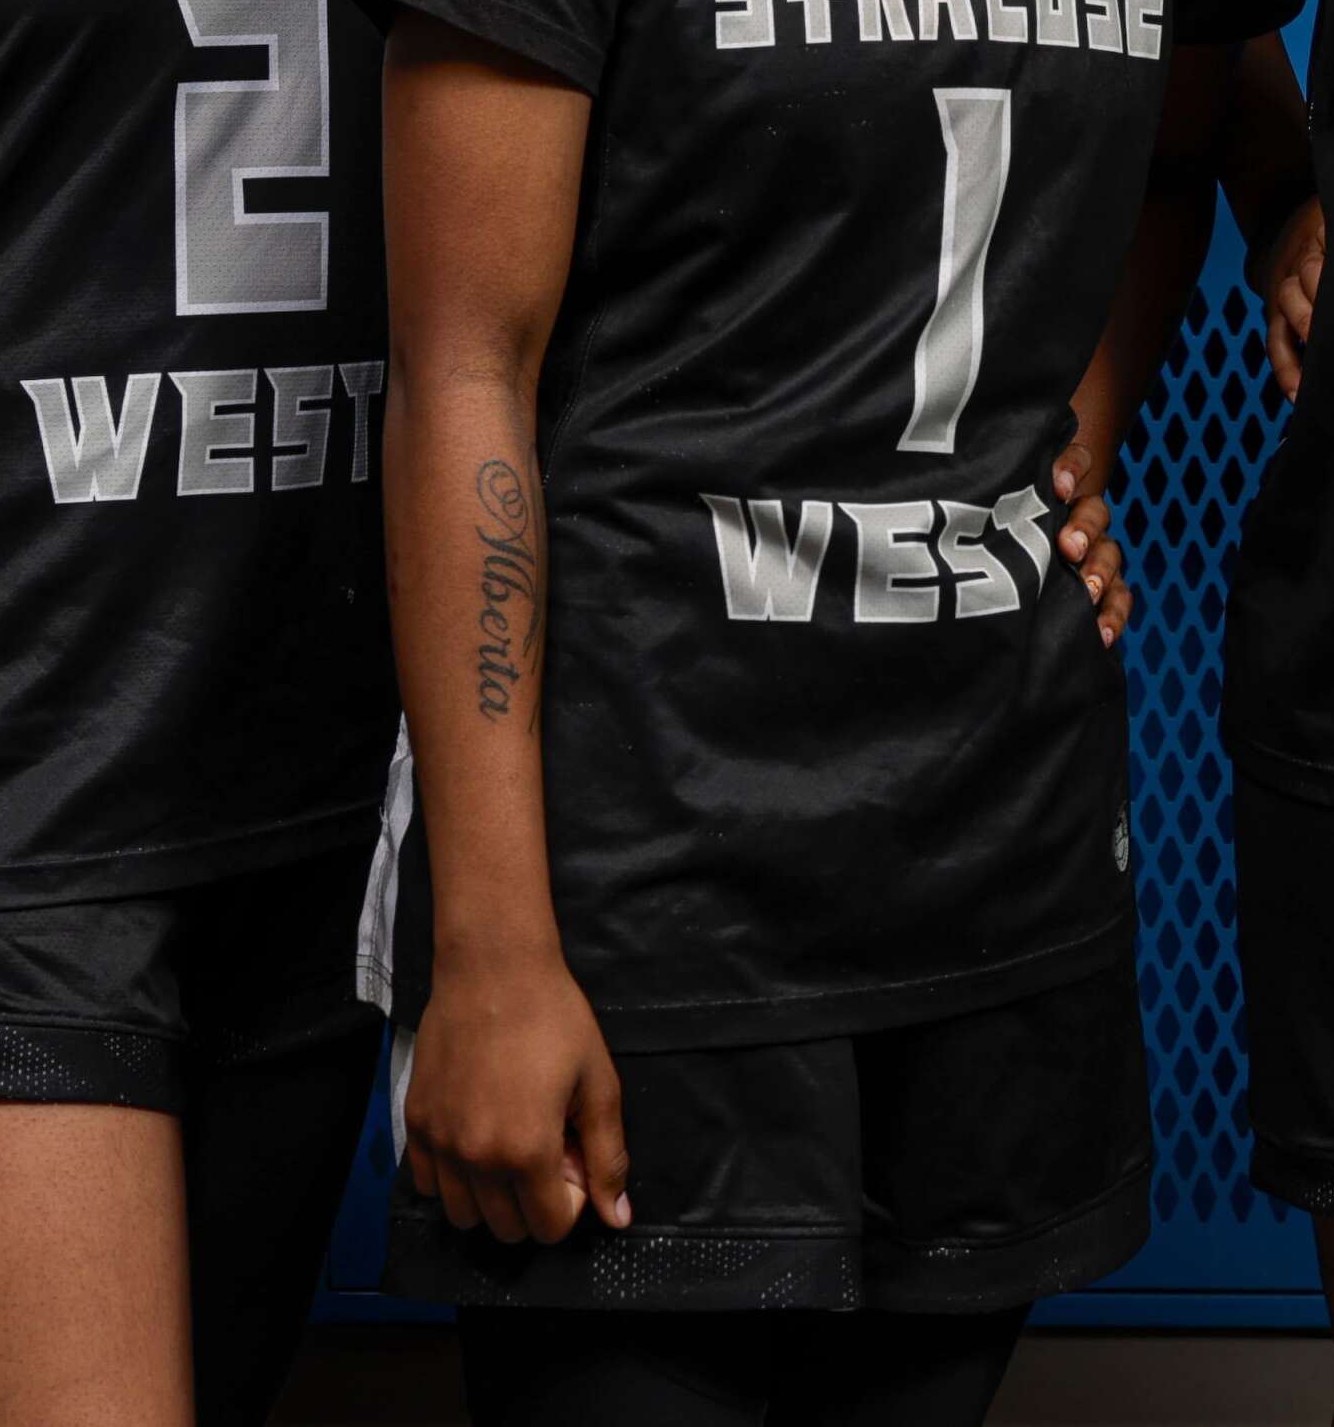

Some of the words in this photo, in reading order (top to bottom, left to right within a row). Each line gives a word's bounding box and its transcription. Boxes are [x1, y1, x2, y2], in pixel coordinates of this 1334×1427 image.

[896, 87, 1012, 454] 1
[19, 360, 385, 505] WEST
[475, 459, 536, 723] Alberta
[698, 484, 1051, 623] WEST
